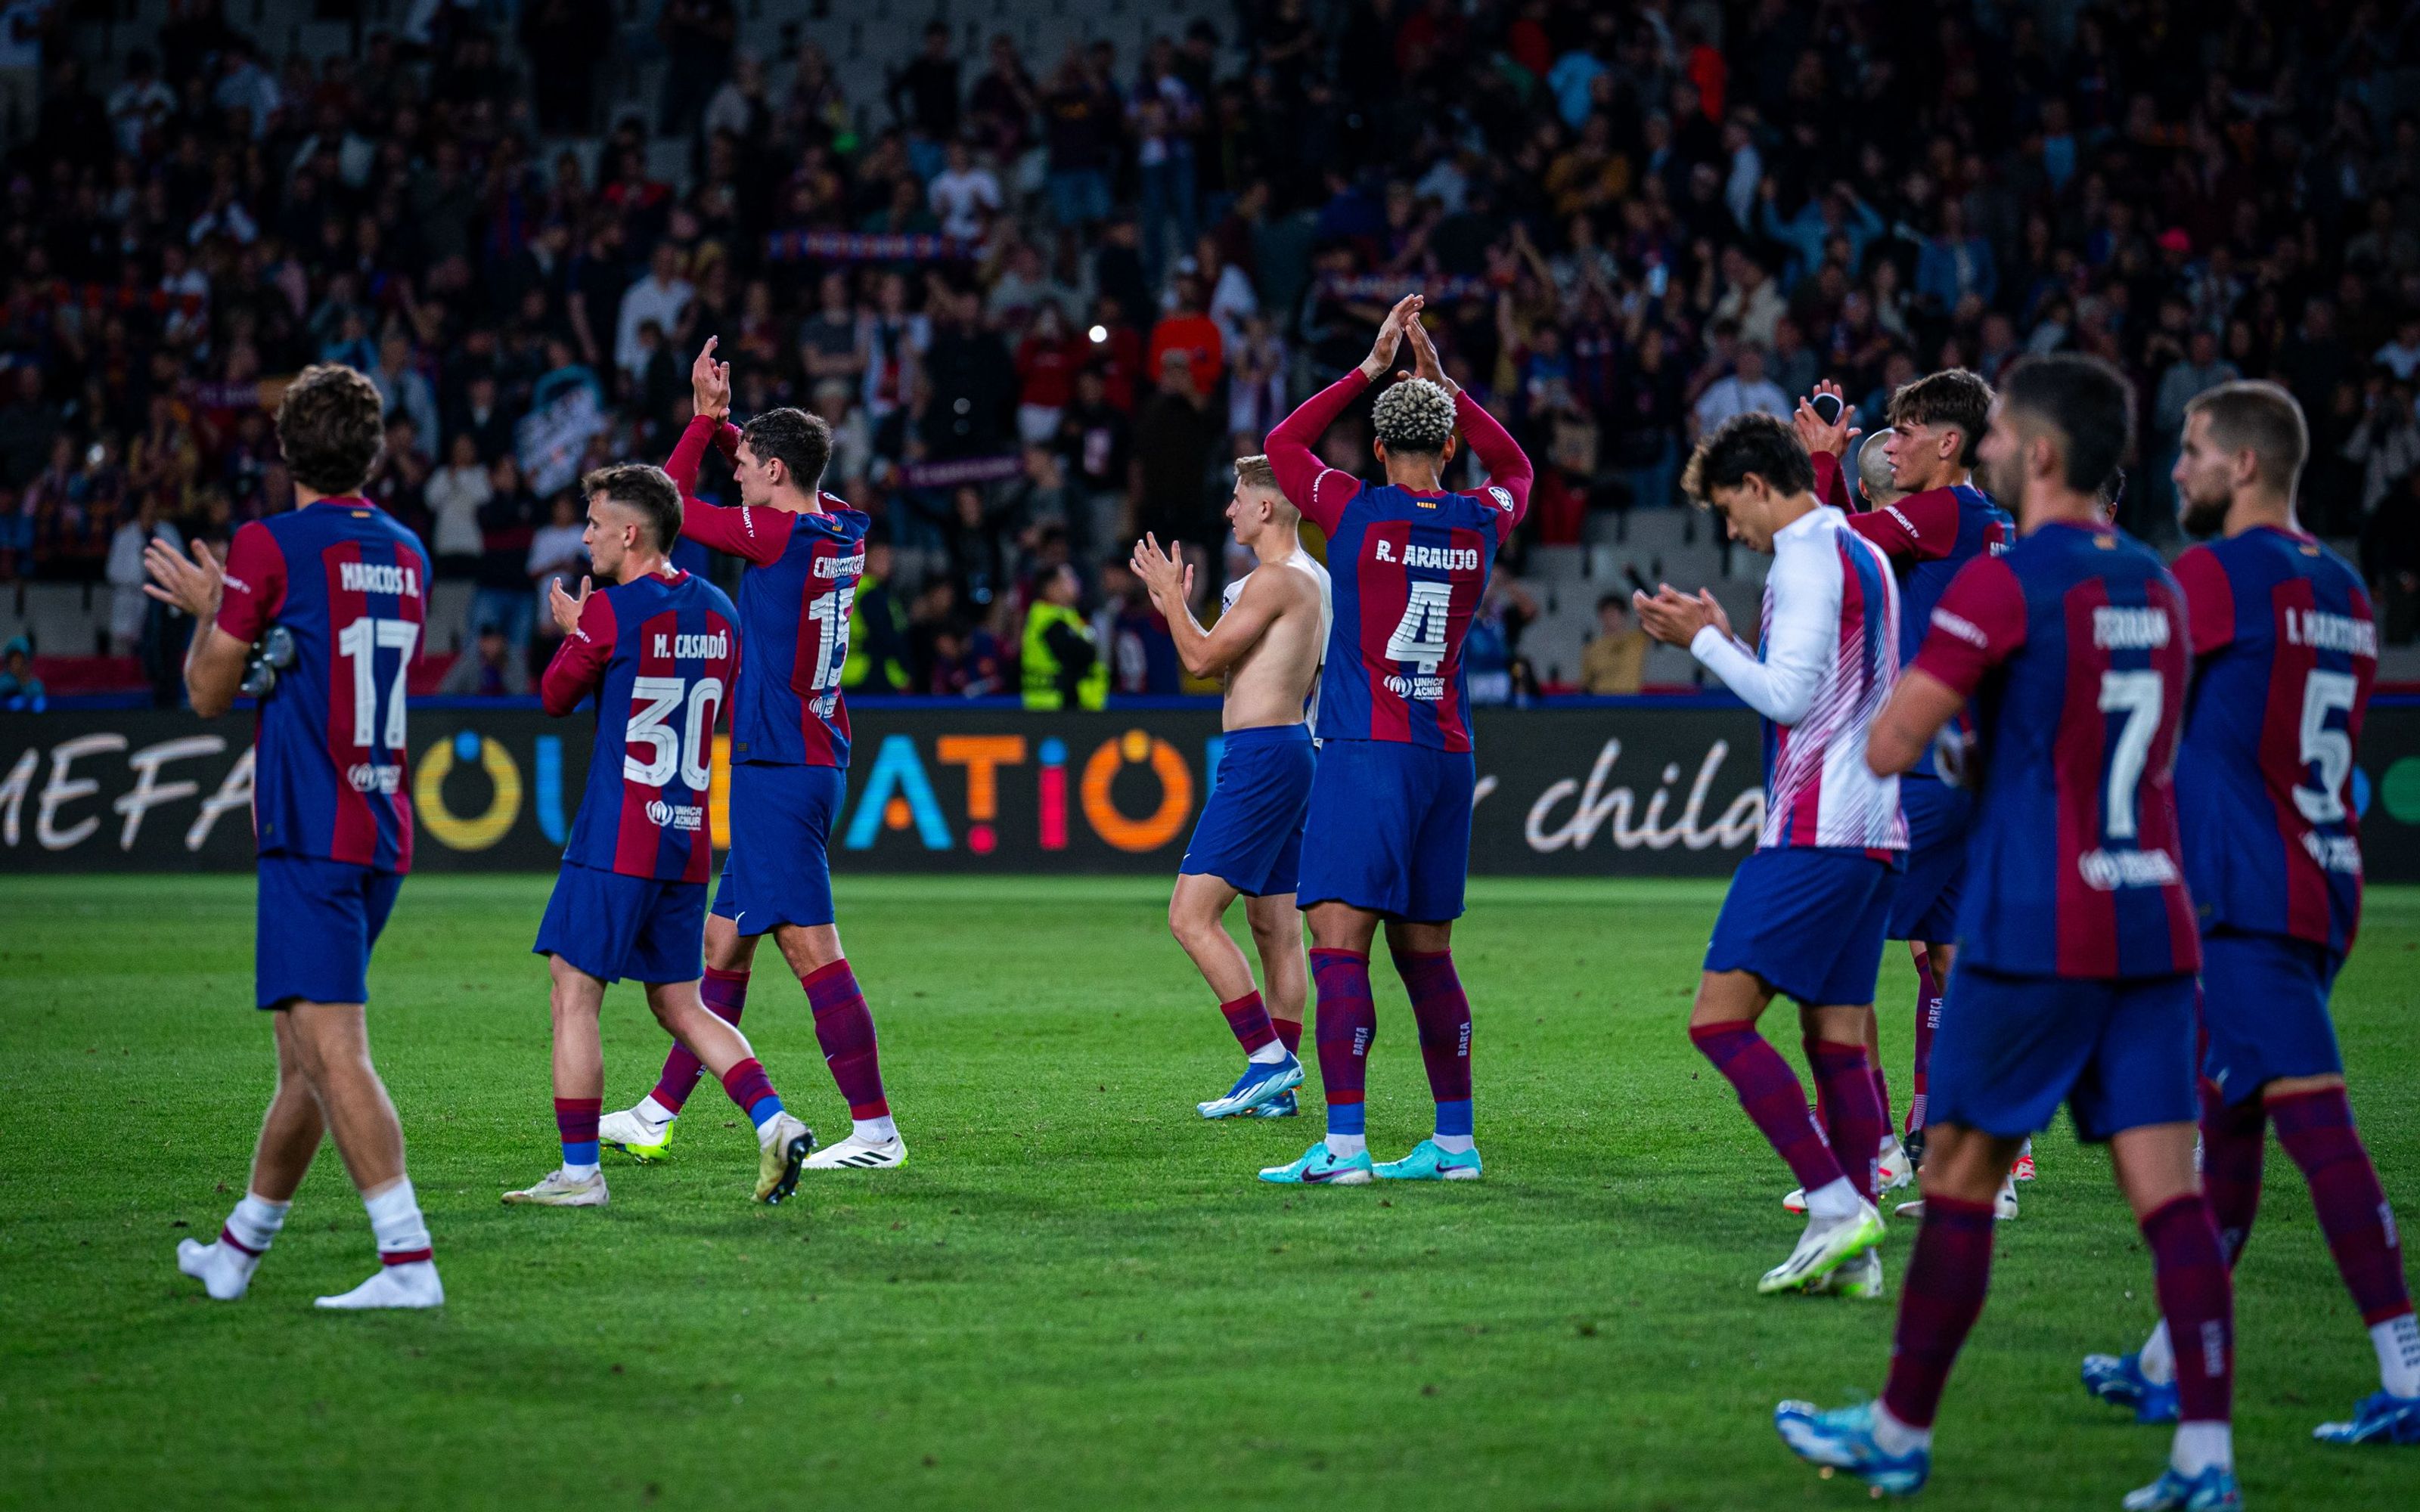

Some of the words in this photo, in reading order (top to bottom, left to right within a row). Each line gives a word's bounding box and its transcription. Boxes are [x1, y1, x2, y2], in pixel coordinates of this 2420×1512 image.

[1376, 540, 1397, 562] R.
[1402, 544, 1478, 570] ARAUJO
[340, 562, 405, 596] MARCOS
[653, 634, 671, 658] M.
[674, 629, 728, 660] CASADÓ
[808, 587, 857, 690] 15
[1385, 581, 1454, 674] 4
[339, 616, 420, 750] 17
[1413, 677, 1446, 687] UNHCR
[1413, 686, 1444, 696] ACNUR
[623, 677, 723, 792] 30
[2291, 669, 2360, 826] 5
[2097, 668, 2164, 840] 7
[674, 804, 703, 816] UNHCR
[1353, 1027, 1369, 1056] BARÇA
[1457, 1021, 1471, 1057] BARÇA
